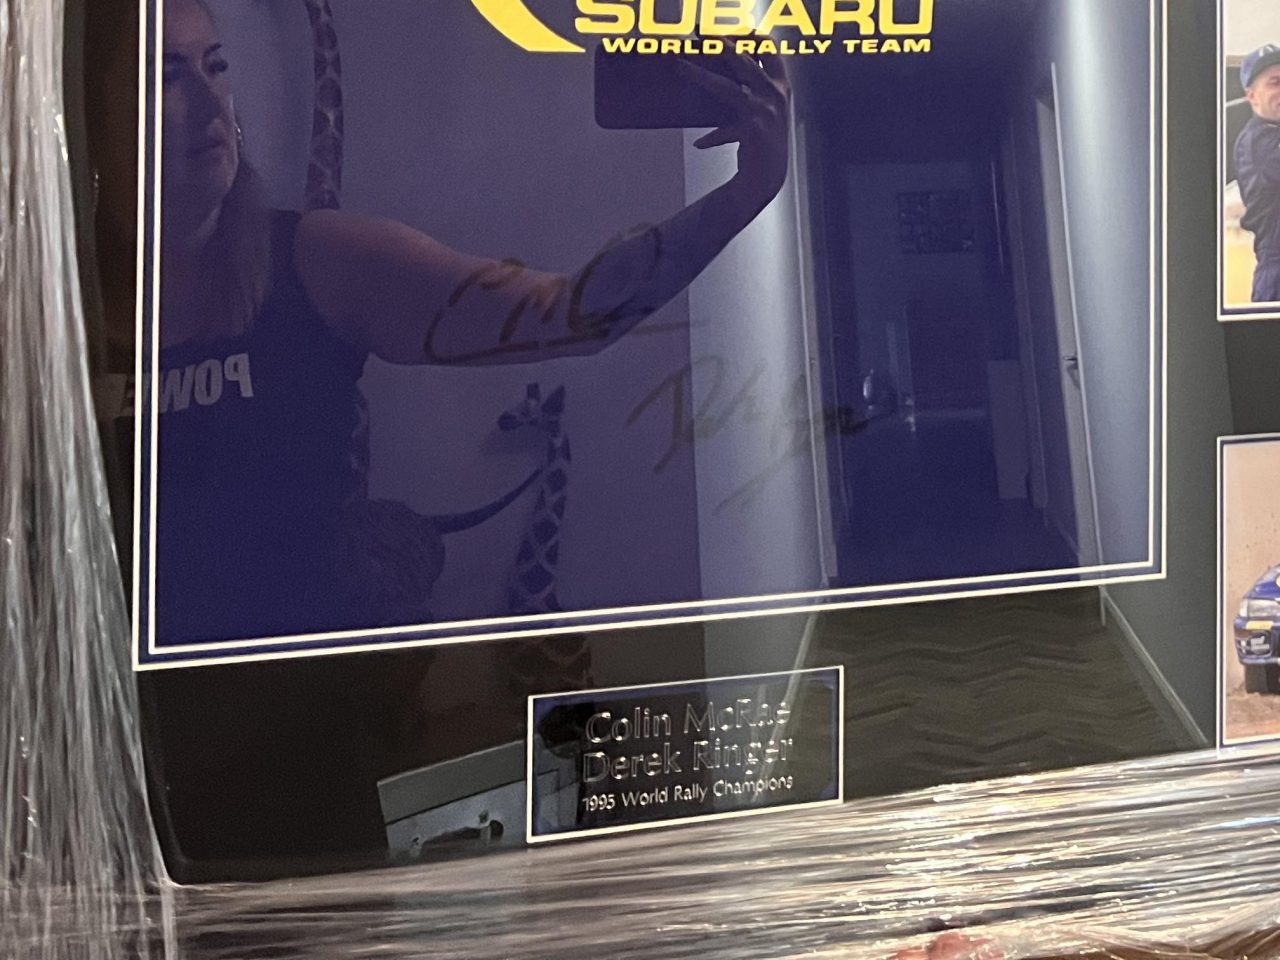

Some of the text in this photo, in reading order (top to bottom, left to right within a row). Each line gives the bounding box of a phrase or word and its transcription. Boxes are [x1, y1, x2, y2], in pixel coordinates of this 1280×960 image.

[602, 38, 931, 55] WORLD RALLY TEAM
[586, 698, 791, 742] Colin McRae
[583, 737, 793, 782] Derek Ringer
[583, 775, 793, 811] 1995 World Rally Champions
